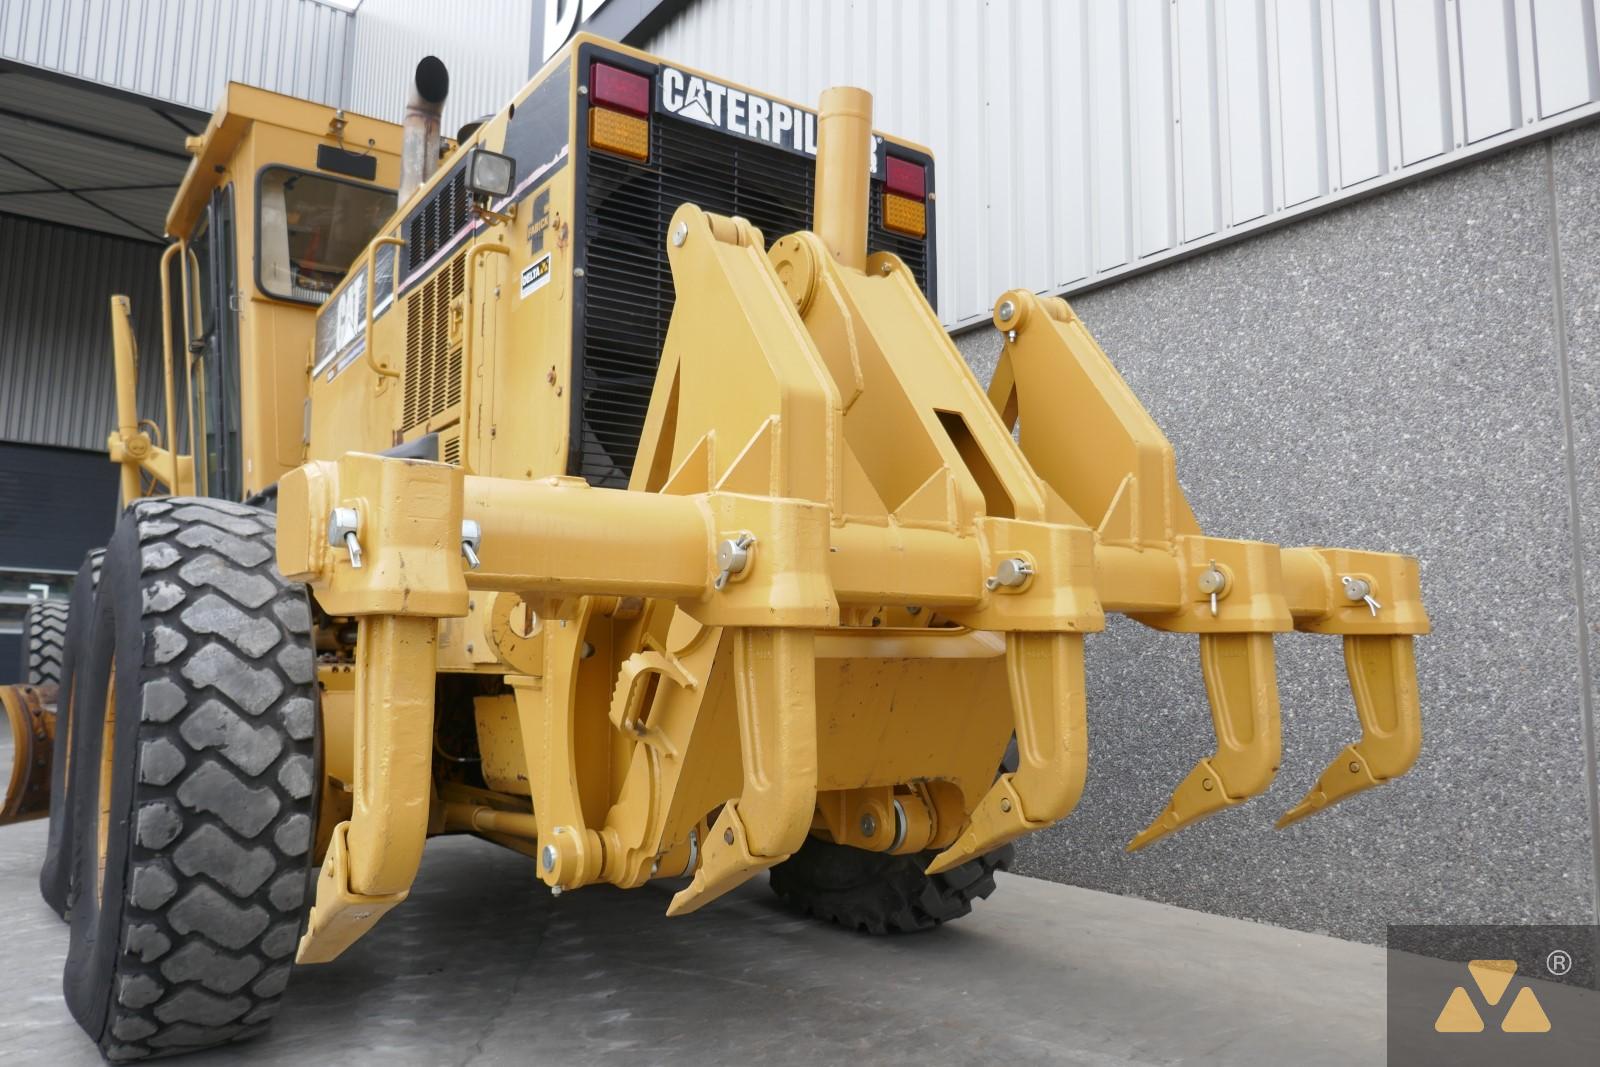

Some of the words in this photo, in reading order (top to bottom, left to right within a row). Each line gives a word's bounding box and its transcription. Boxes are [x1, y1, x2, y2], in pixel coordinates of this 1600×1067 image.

[662, 67, 878, 173] CATERPIL
[336, 272, 365, 352] CAT
[522, 266, 540, 286] DELTA
